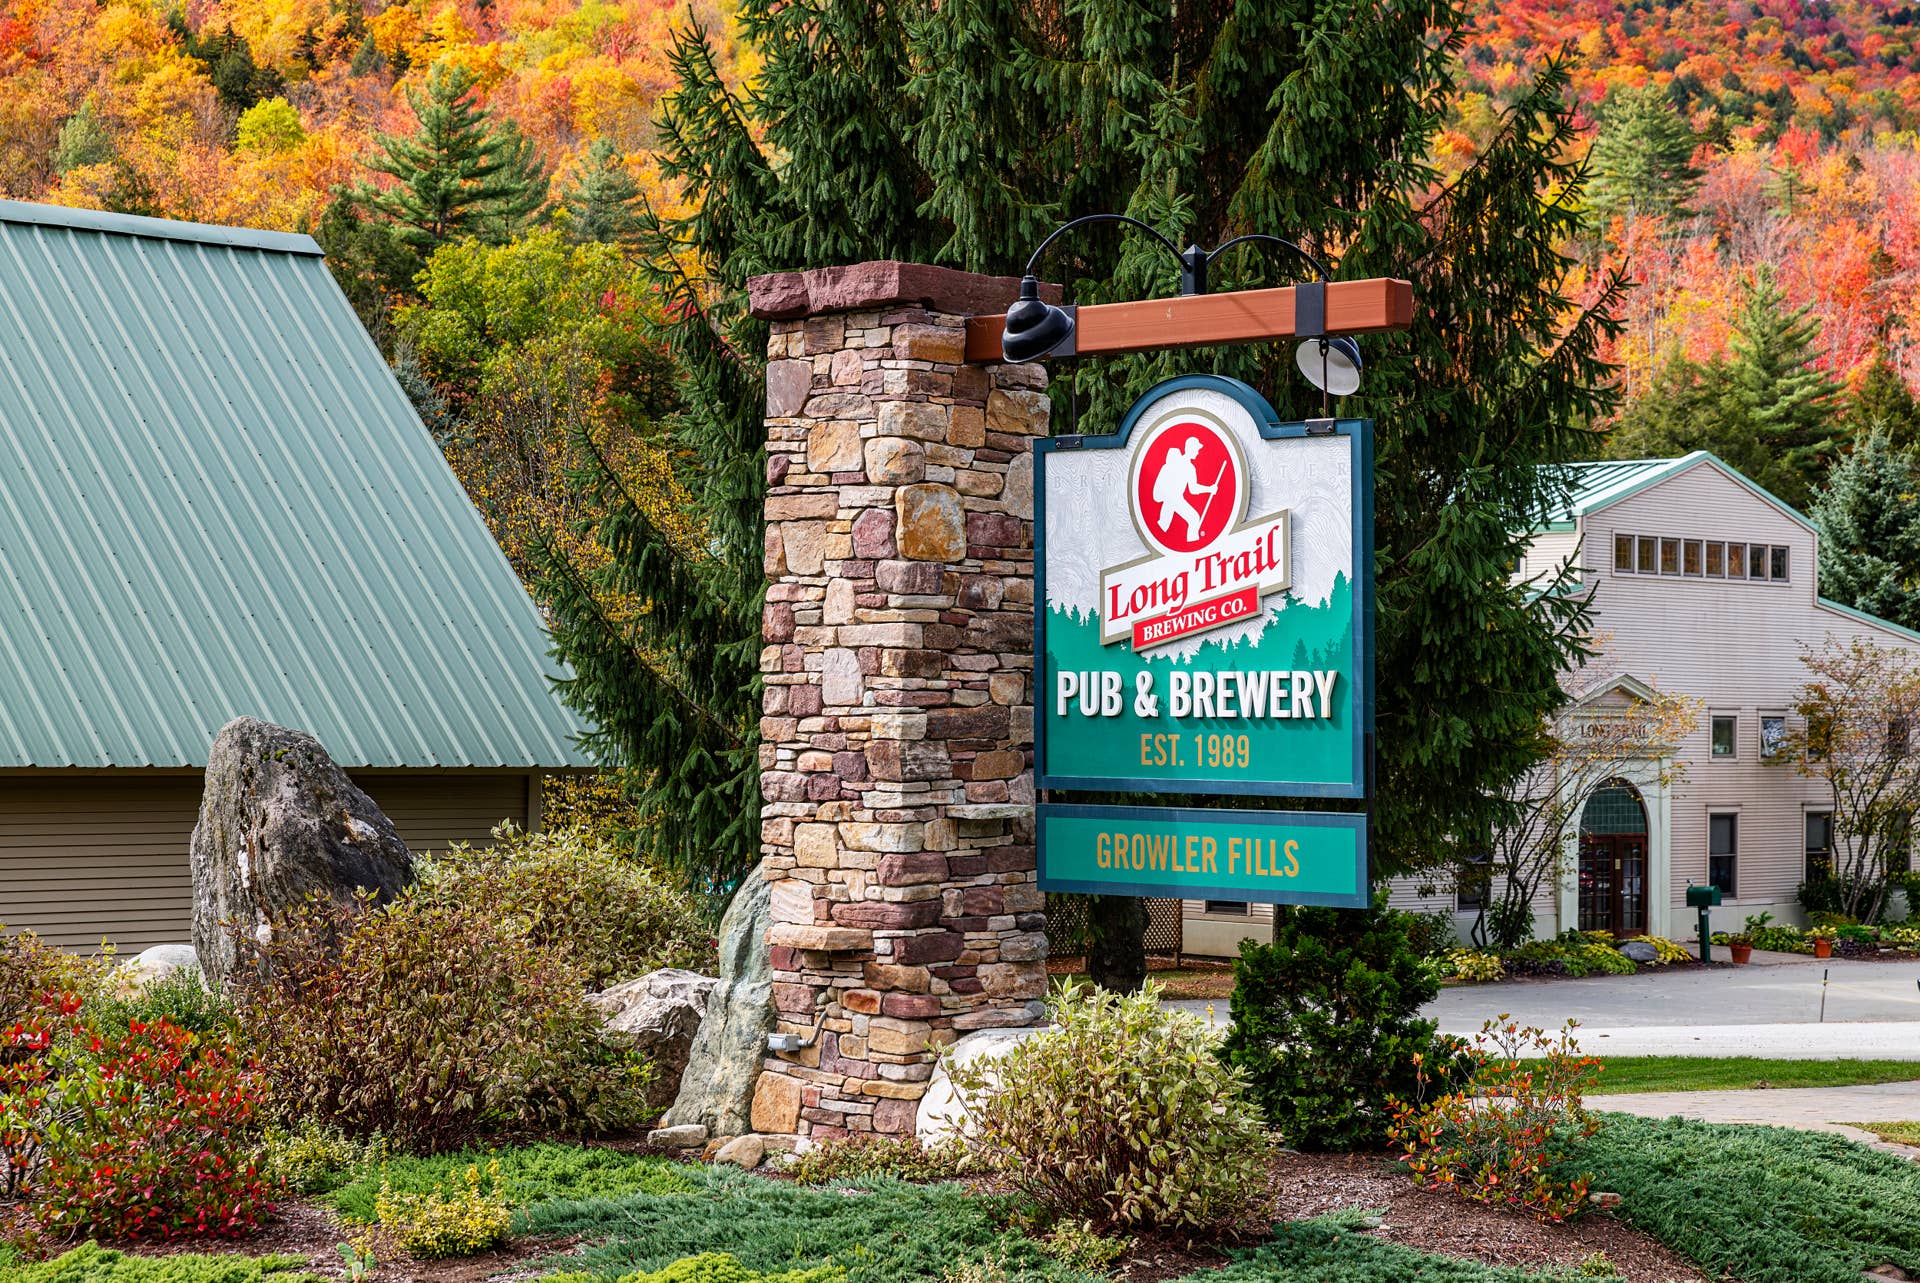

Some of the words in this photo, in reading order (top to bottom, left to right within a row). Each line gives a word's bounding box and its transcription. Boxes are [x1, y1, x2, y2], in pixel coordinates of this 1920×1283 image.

[1107, 571, 1189, 616] Long
[1195, 525, 1280, 593] Trail
[1143, 609, 1217, 642] BREWING
[1220, 598, 1247, 617] CO.
[1057, 671, 1124, 717] PUB
[1134, 671, 1159, 718] &
[1170, 670, 1337, 719] BREWERY
[1140, 733, 1185, 766] EST.
[1195, 734, 1250, 768] 1989
[1096, 832, 1218, 873] GROWLER
[1228, 837, 1301, 878] FILLS
